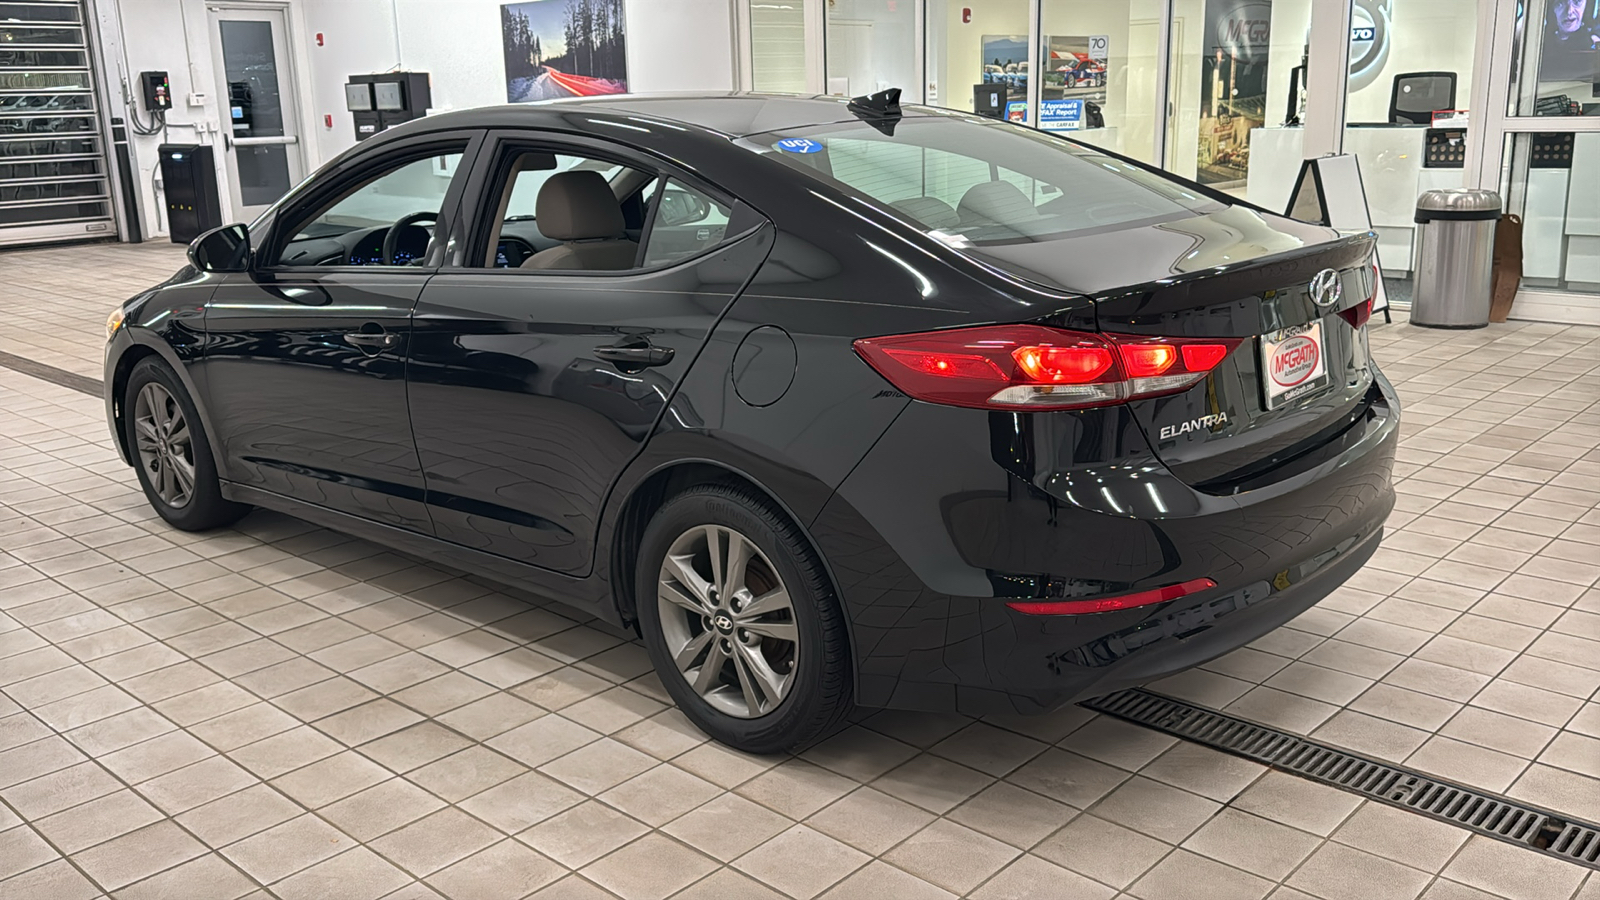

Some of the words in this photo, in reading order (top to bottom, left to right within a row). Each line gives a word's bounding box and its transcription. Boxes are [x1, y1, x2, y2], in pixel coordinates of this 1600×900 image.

[1091, 38, 1106, 49] 70
[1046, 102, 1074, 110] Appraisal
[1160, 411, 1228, 439] ELANTRA
